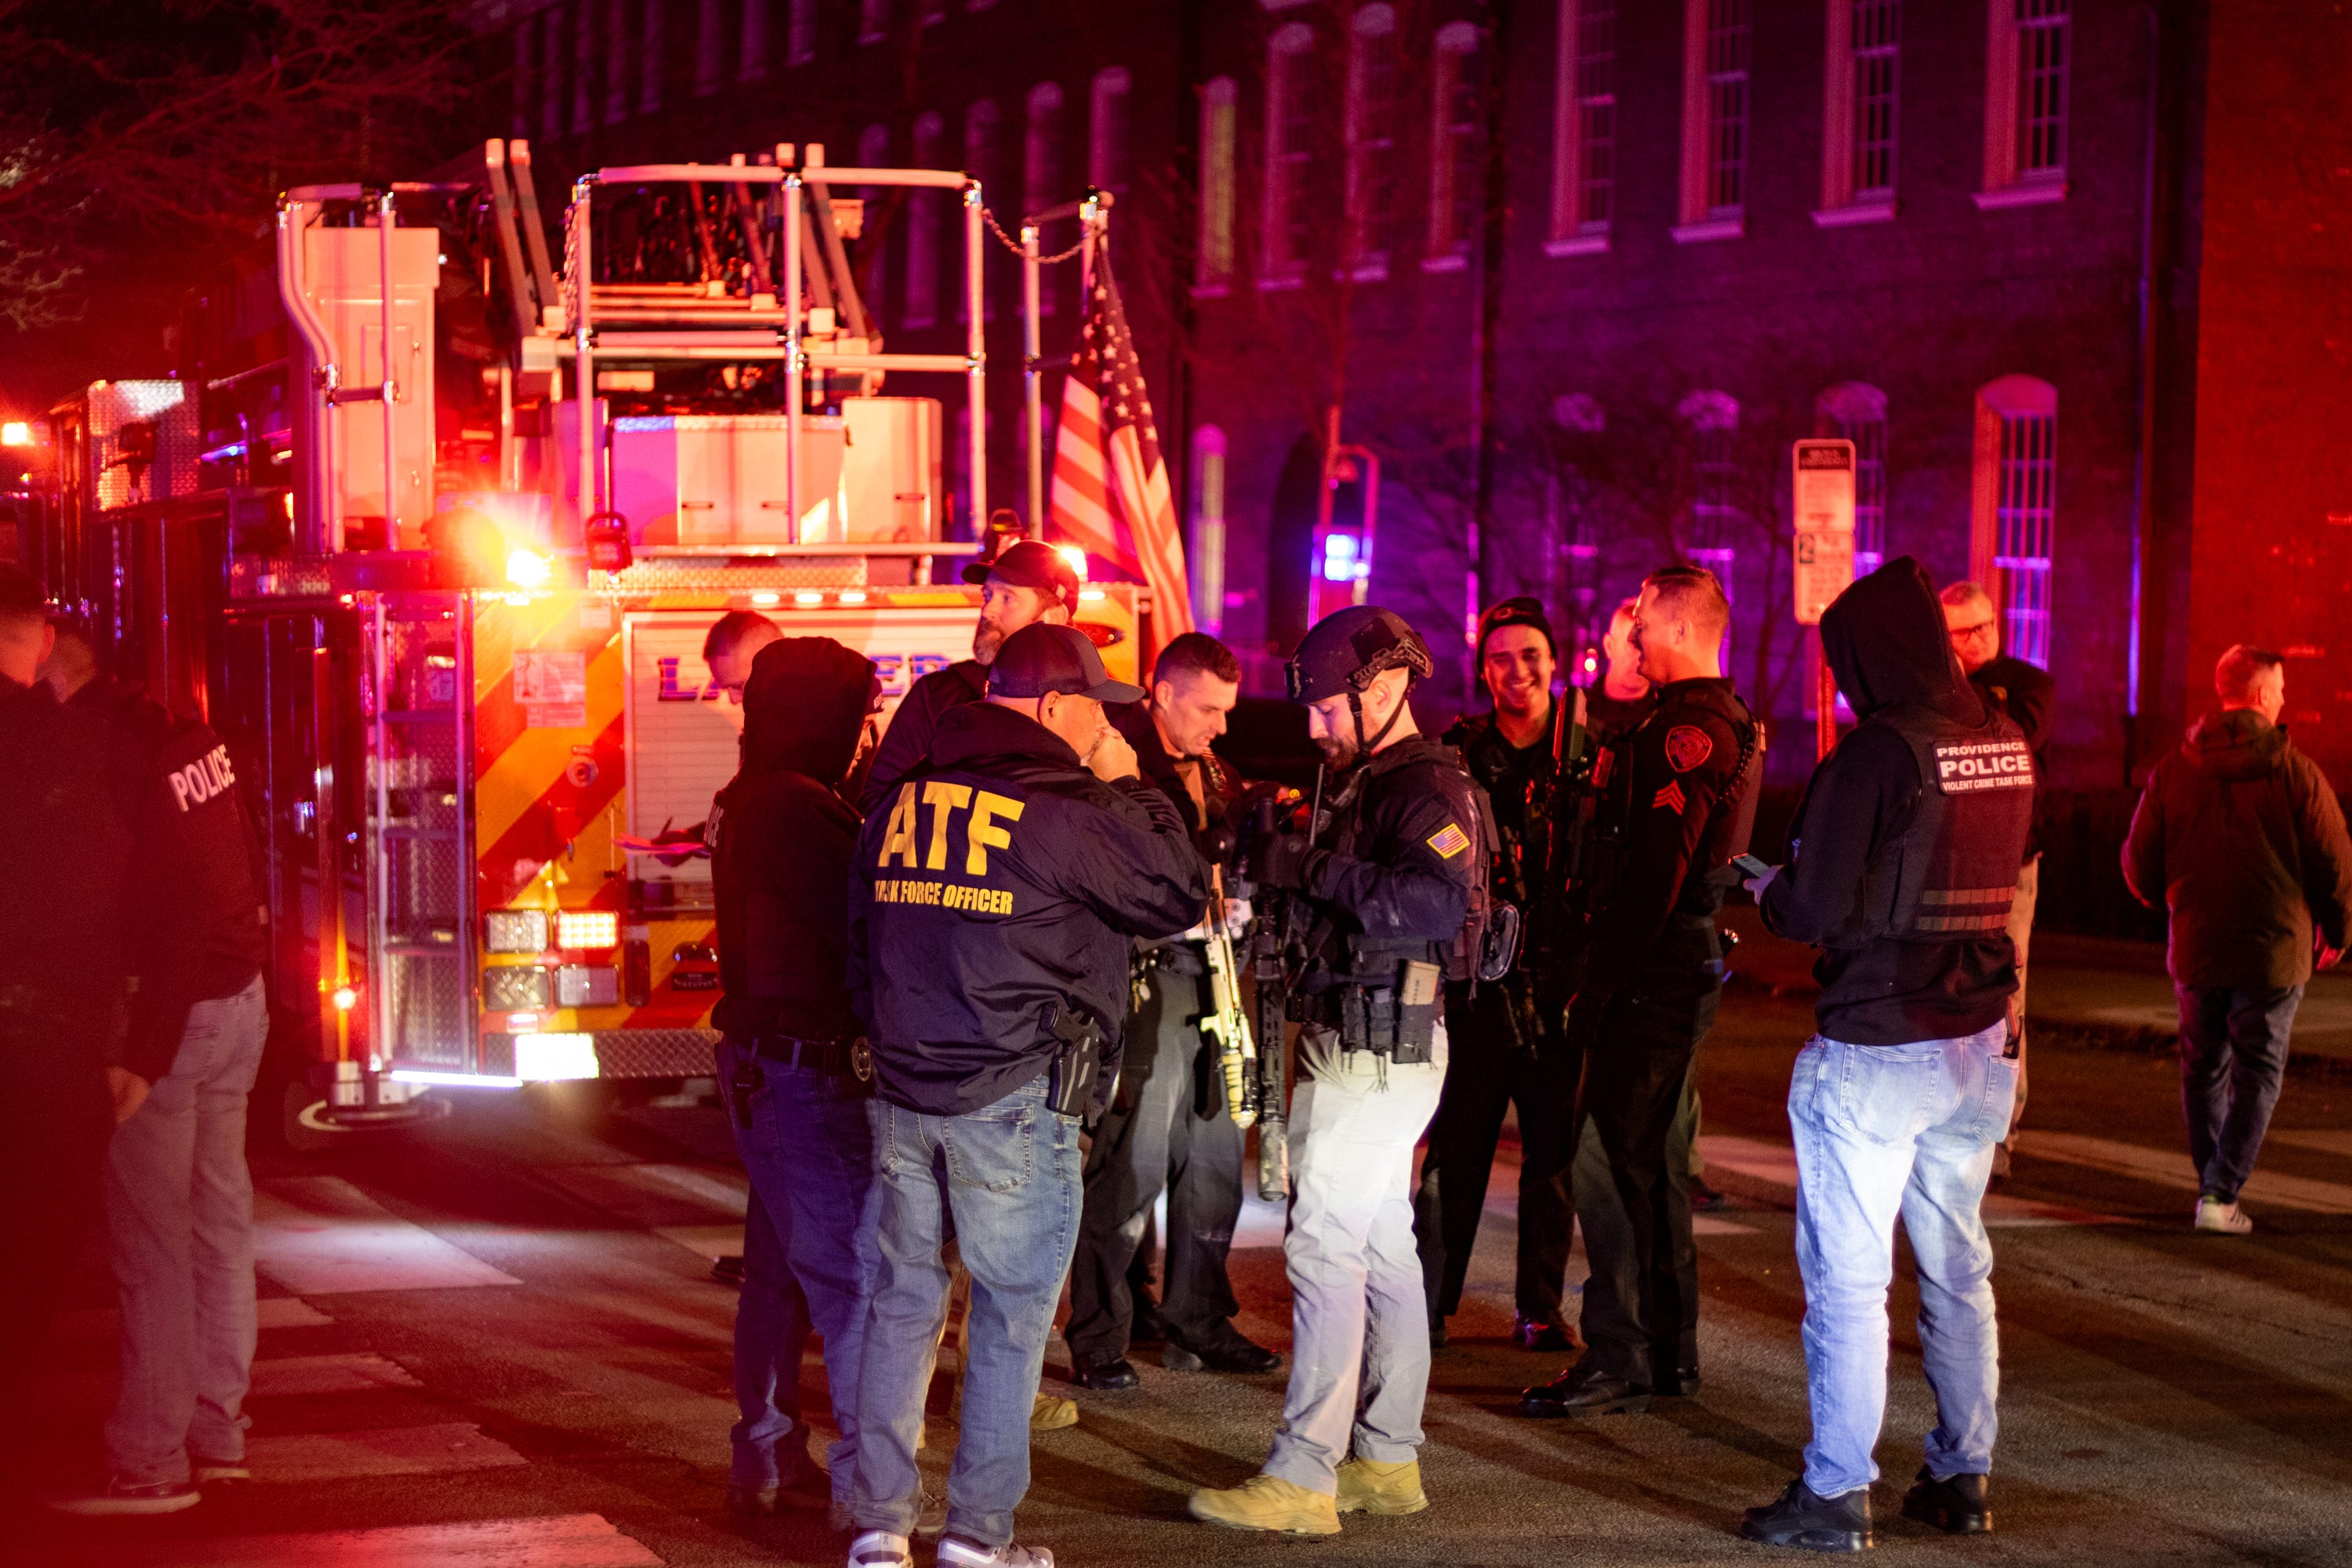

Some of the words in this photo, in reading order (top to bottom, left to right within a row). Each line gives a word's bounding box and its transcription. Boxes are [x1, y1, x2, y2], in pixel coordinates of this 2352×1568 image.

[1936, 742, 2026, 757] PROVIDENCE
[168, 744, 235, 811] POLICE
[1940, 755, 2031, 778] POLICE
[1943, 780, 1973, 791] VIOLENT
[1974, 778, 1994, 789] CRIME
[1995, 776, 2013, 786] TASK
[2013, 775, 2032, 785] FORCE
[878, 781, 1025, 876] ATF
[875, 880, 900, 902] TASK
[900, 880, 942, 905] FORCE
[942, 884, 1013, 914] OFFICER
